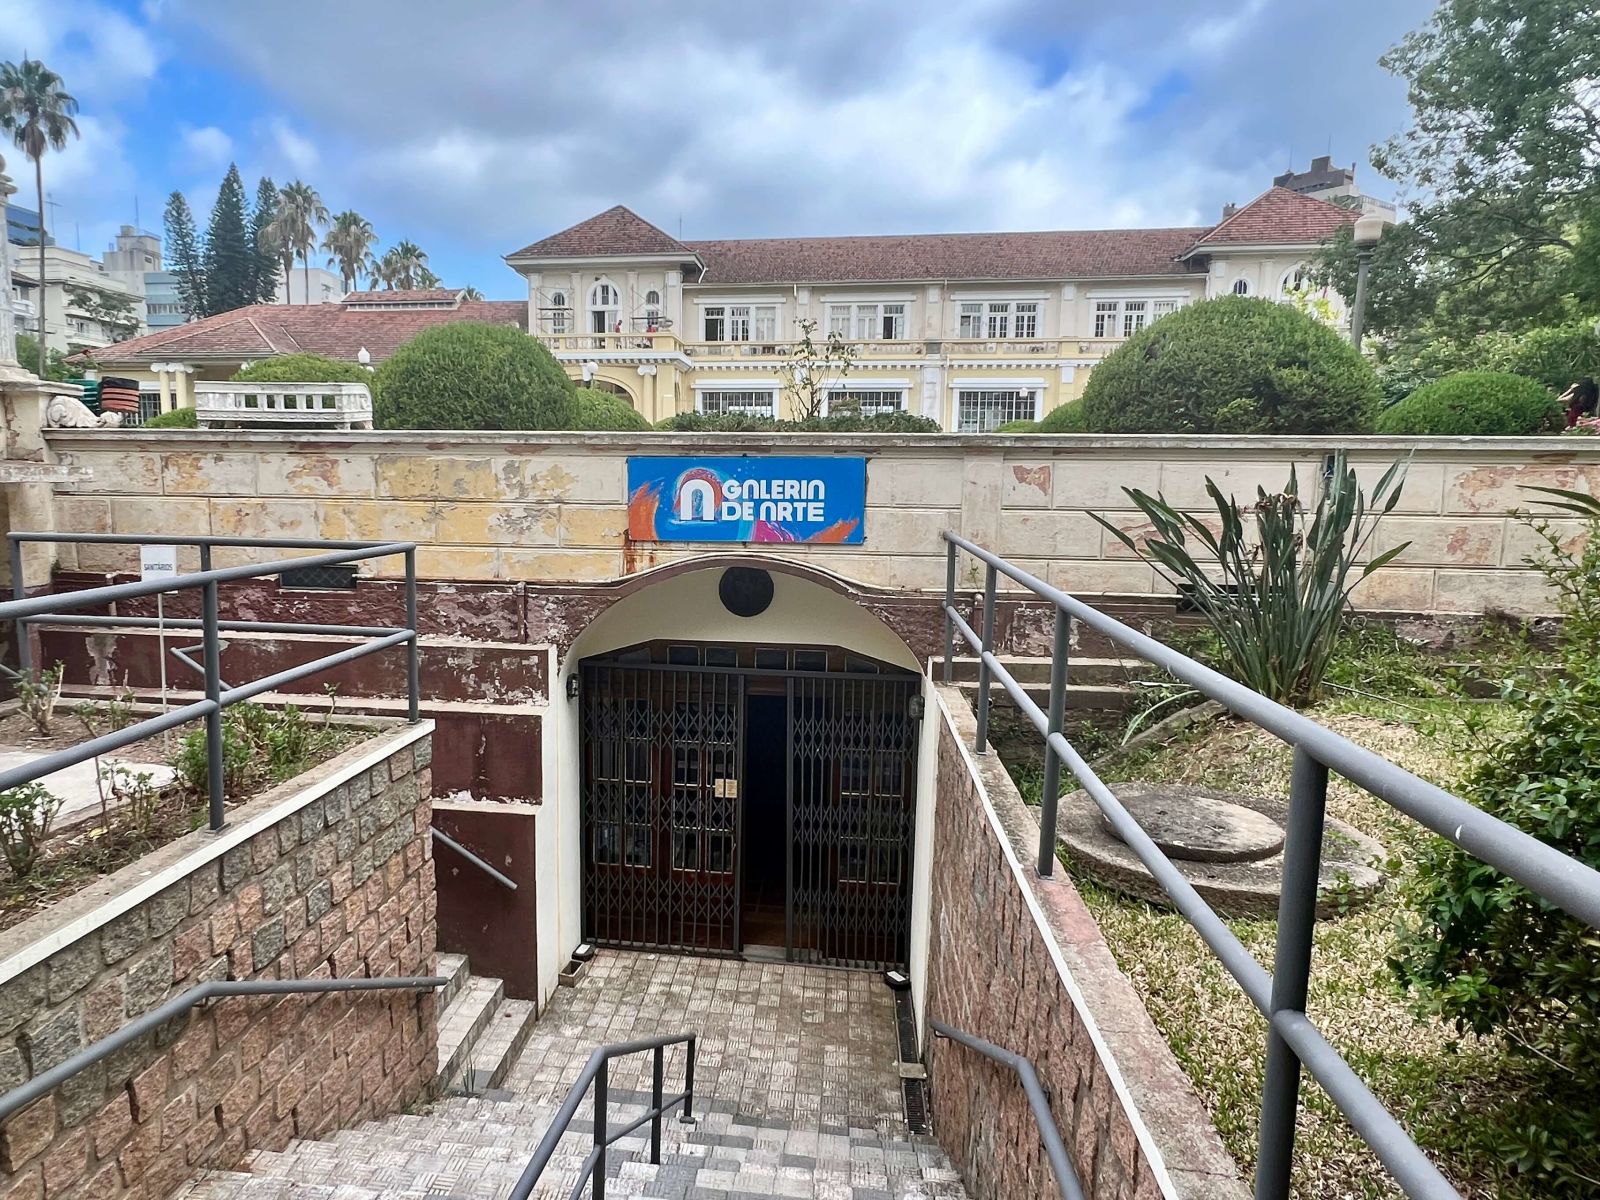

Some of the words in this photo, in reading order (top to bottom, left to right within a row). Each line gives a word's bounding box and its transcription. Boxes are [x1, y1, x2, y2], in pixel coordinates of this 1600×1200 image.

[721, 479, 825, 500] GALERIA
[721, 501, 754, 521] DE
[759, 501, 825, 522] ARTE
